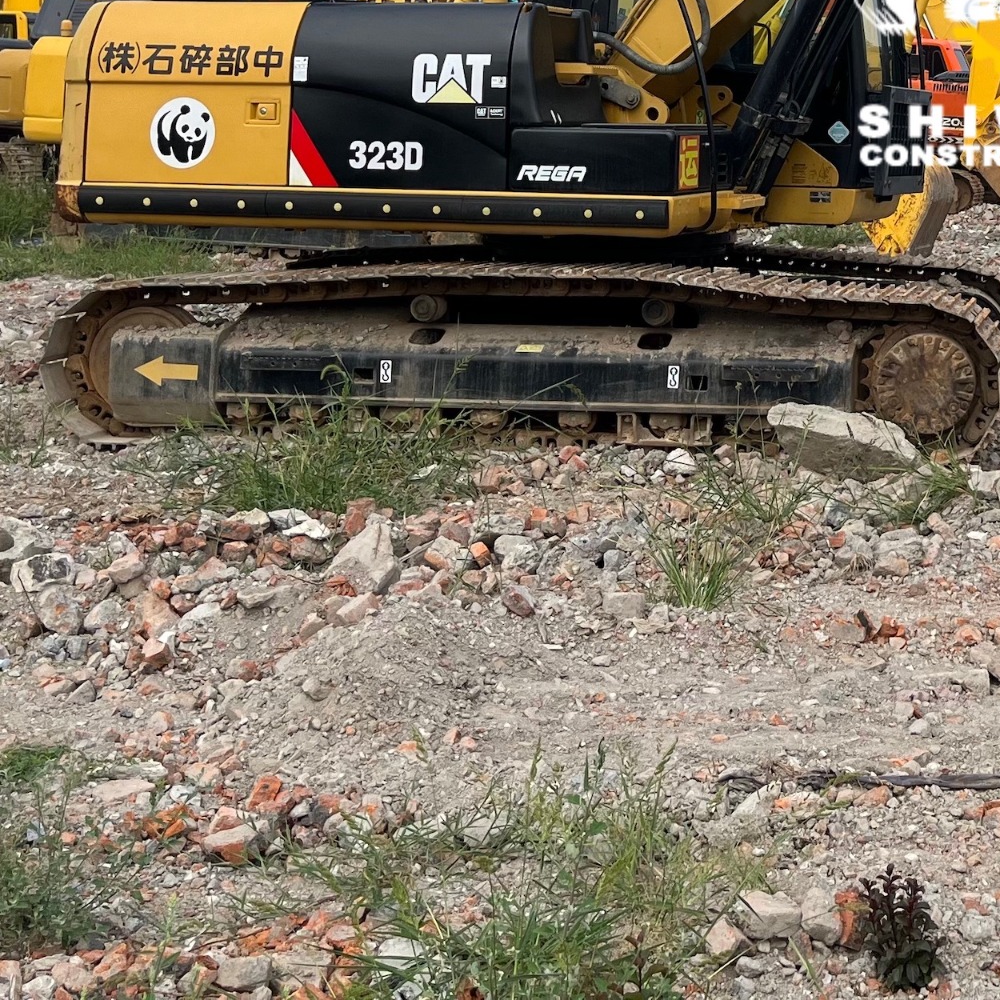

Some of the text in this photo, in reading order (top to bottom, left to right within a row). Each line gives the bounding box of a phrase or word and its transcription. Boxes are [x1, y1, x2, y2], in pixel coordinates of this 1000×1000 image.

[411, 53, 492, 104] CAT
[348, 140, 424, 171] 323D
[516, 164, 587, 183] REGA
